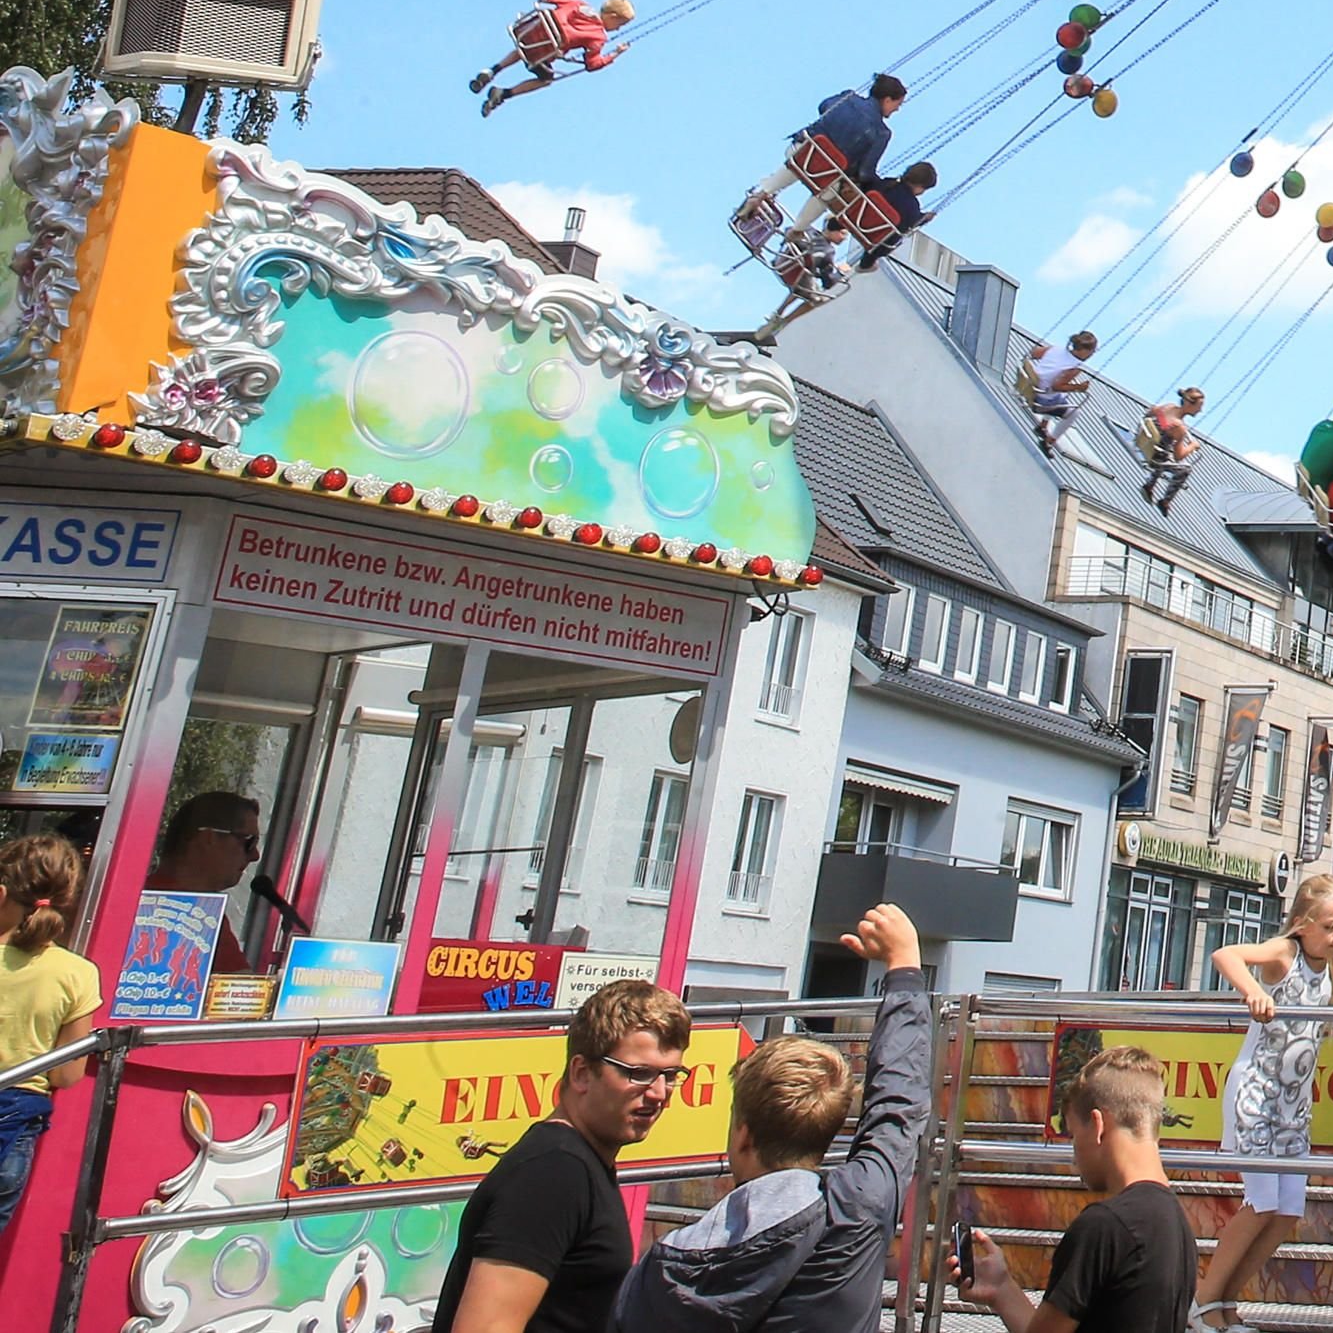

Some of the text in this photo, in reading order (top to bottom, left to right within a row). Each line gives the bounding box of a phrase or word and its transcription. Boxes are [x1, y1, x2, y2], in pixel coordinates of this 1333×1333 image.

[0, 516, 165, 569] ASSE
[238, 528, 684, 625] Betrunkene bzw. Angetrunkene haben
[63, 620, 141, 635] FAHRPREIS
[229, 564, 712, 662] keinen Zutritt und dürfen nicht mitfahren!
[426, 945, 536, 981] CIRCUS
[576, 964, 645, 978] Für selbst-
[439, 1062, 719, 1125] EING
